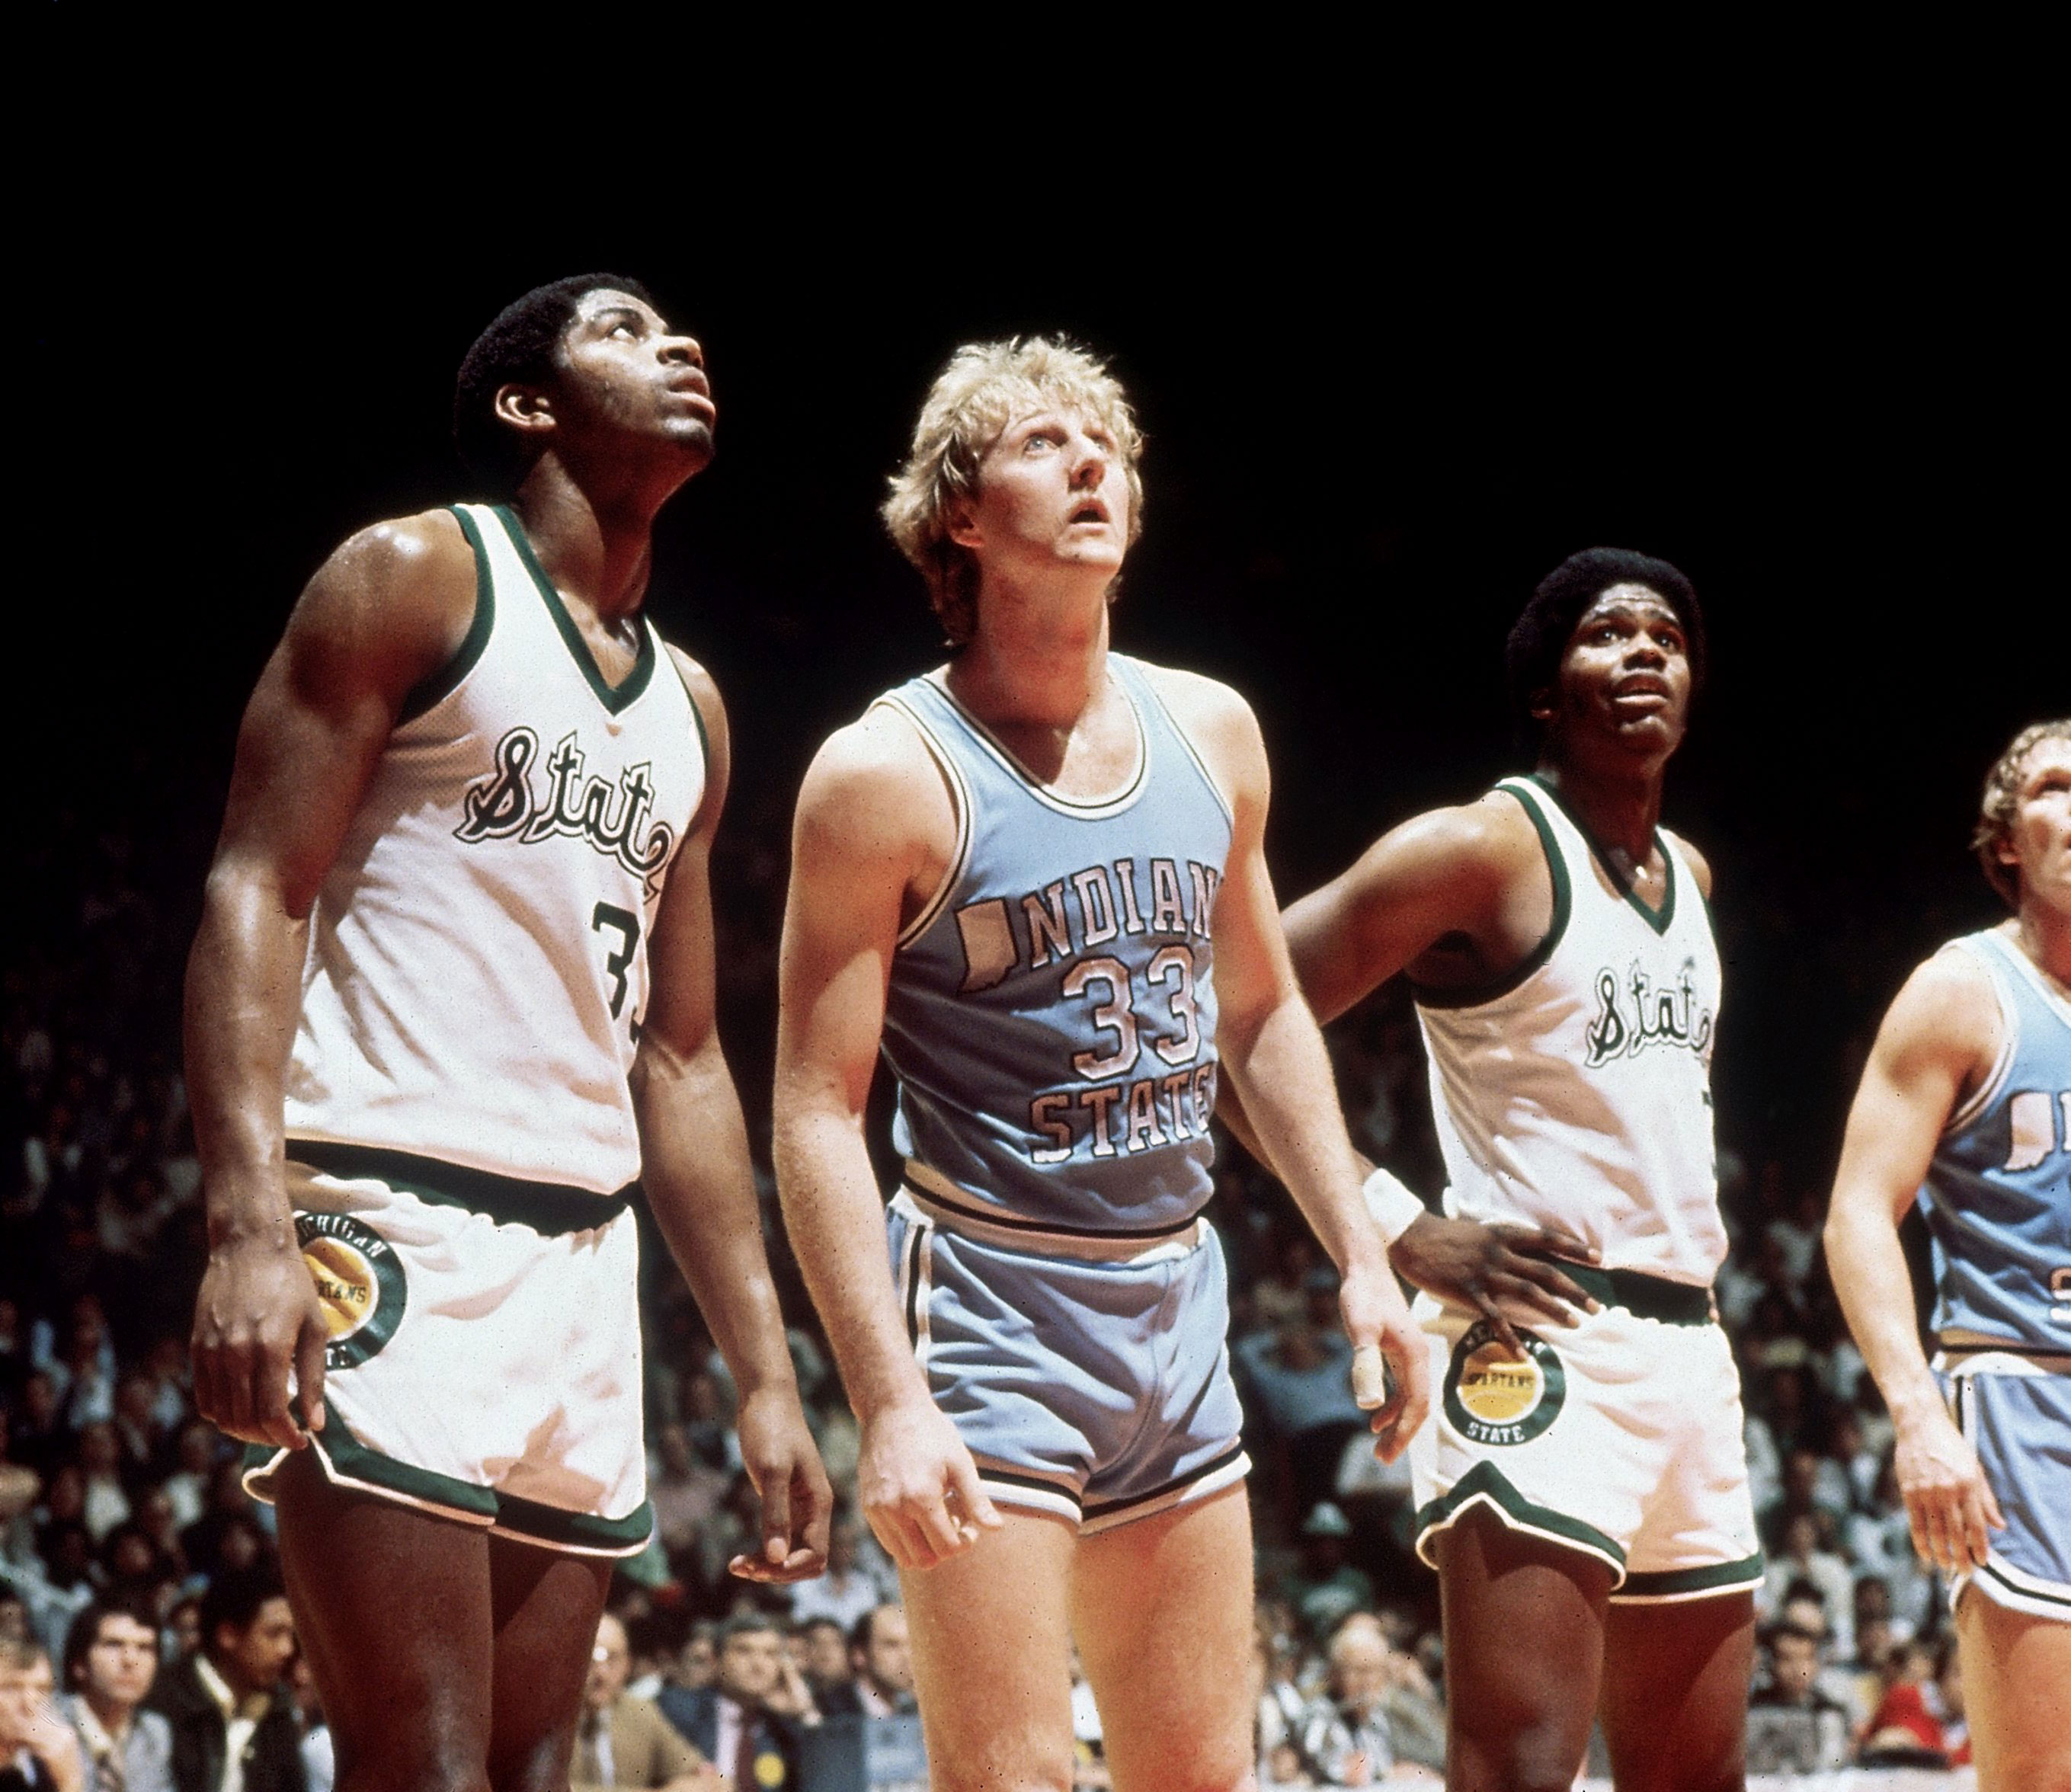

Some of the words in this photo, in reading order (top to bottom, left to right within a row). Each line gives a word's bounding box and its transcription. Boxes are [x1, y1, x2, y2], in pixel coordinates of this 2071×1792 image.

[452, 726, 674, 904] State
[592, 900, 642, 1045] 3
[955, 856, 1218, 992] INDIAN
[1062, 942, 1201, 1083] 33
[1585, 957, 1711, 1068] State
[1029, 1061, 1215, 1164] STATE
[1466, 1421, 1525, 1444] STATE
